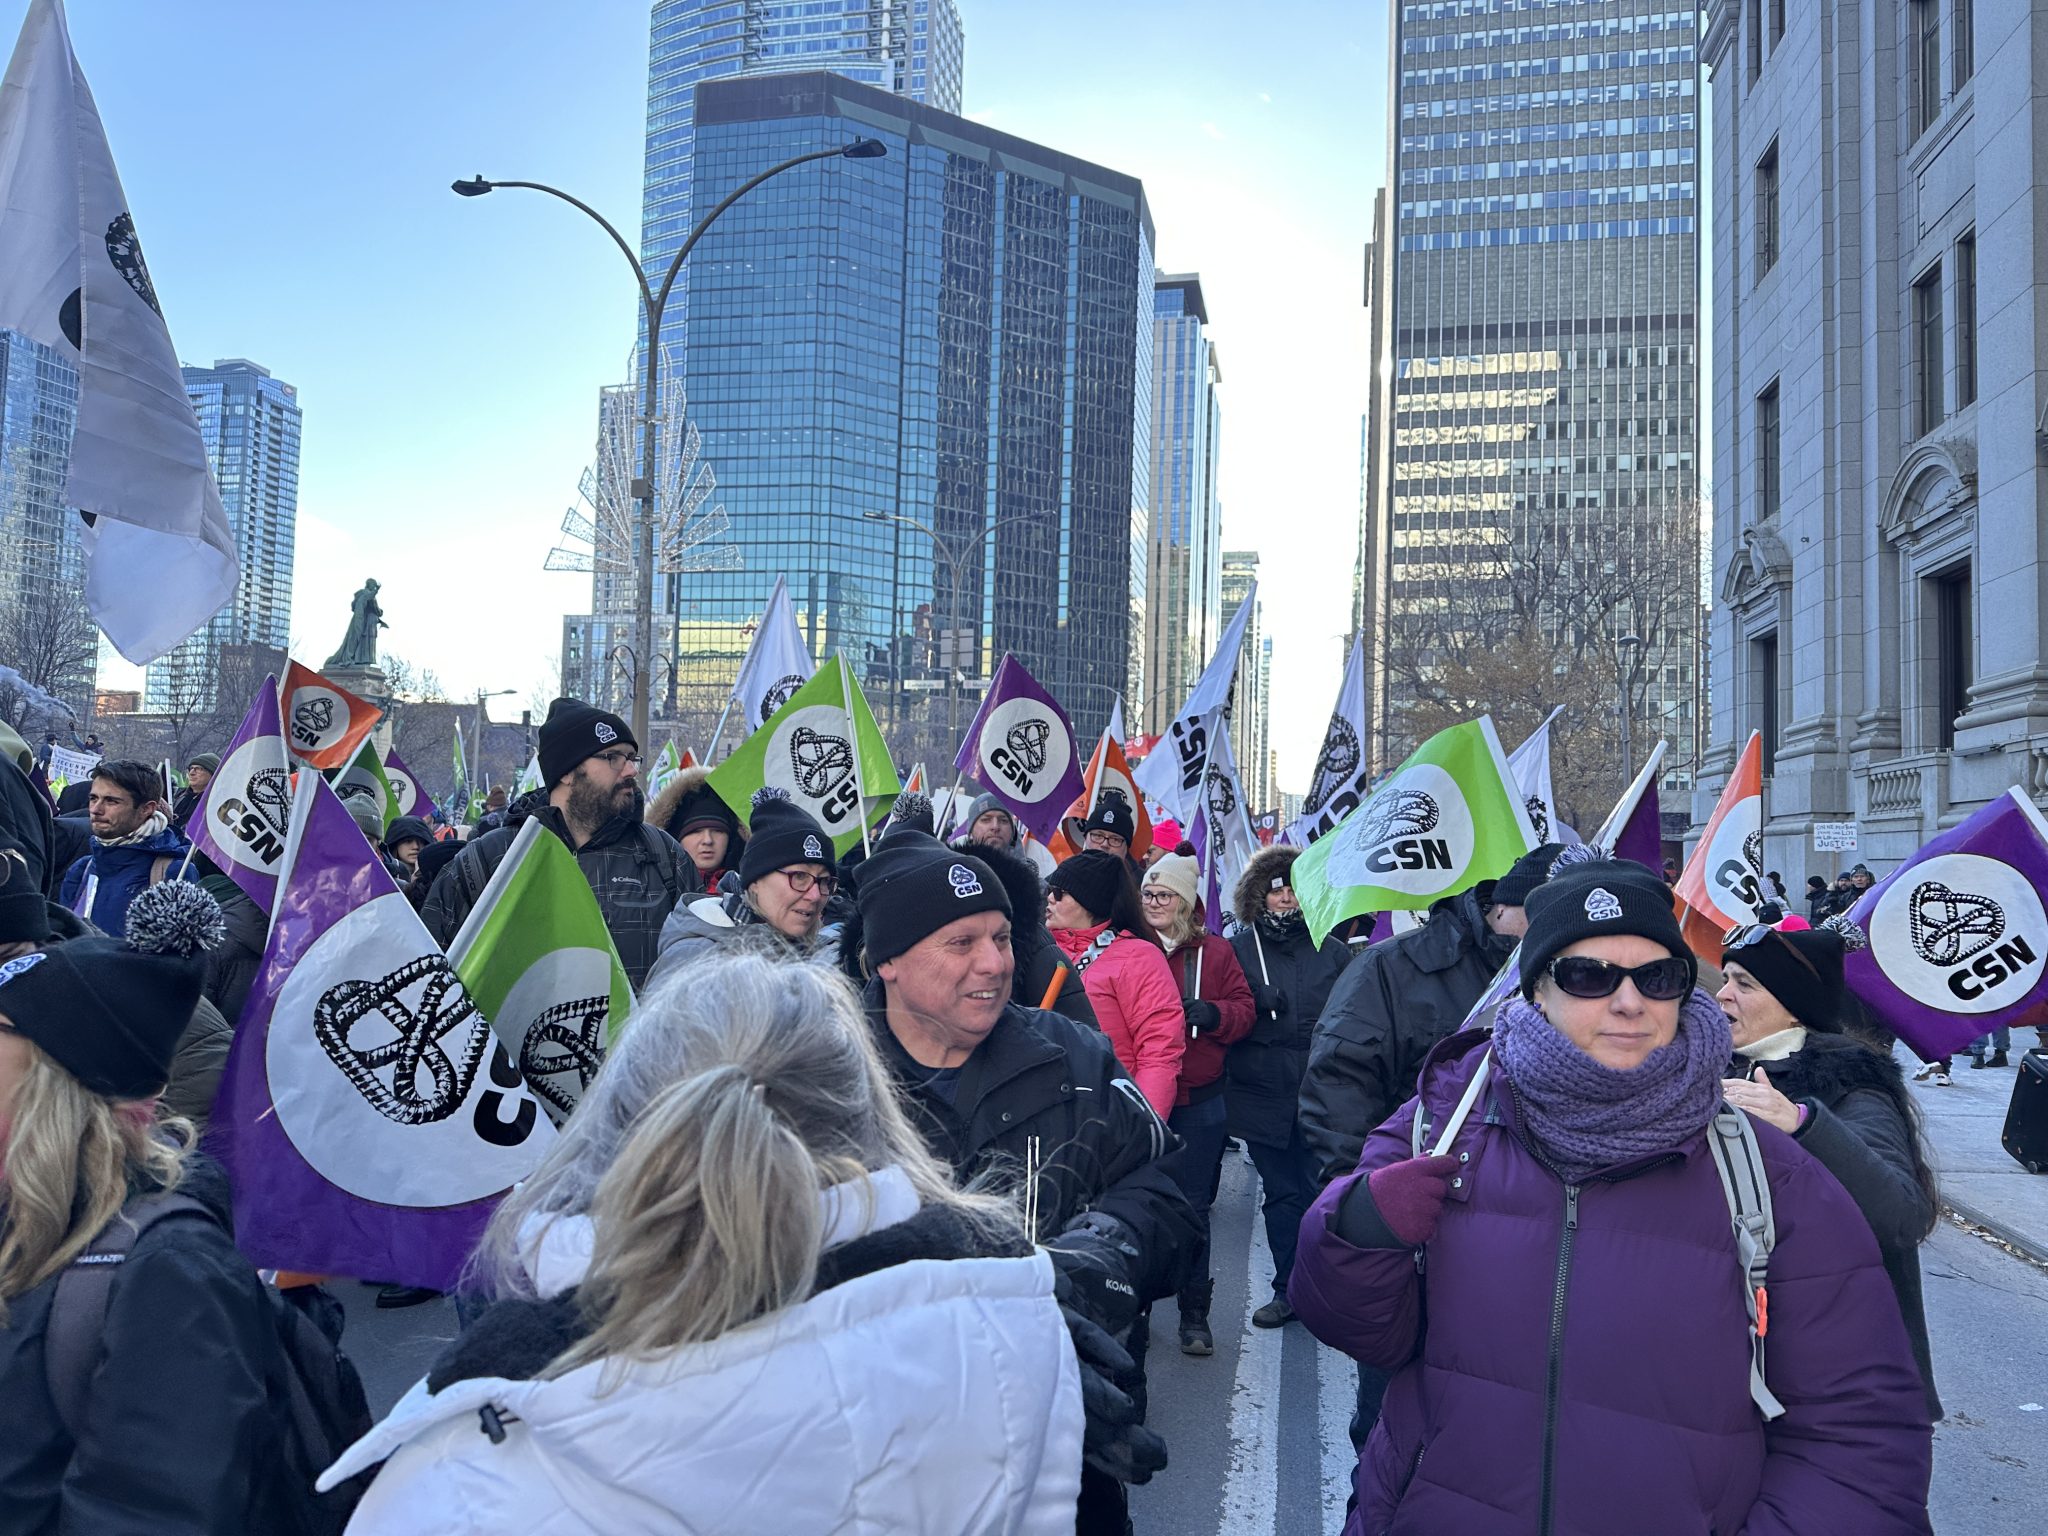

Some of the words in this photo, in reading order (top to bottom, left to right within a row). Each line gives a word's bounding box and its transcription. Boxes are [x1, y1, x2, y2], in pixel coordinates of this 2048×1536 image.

[990, 748, 1033, 796] CSN
[822, 775, 859, 824] CS
[217, 798, 284, 866] CSN
[1365, 839, 1453, 873] CSN
[957, 884, 981, 896] CSN
[1590, 908, 1621, 920] CSN
[1947, 934, 2037, 1000] CSN
